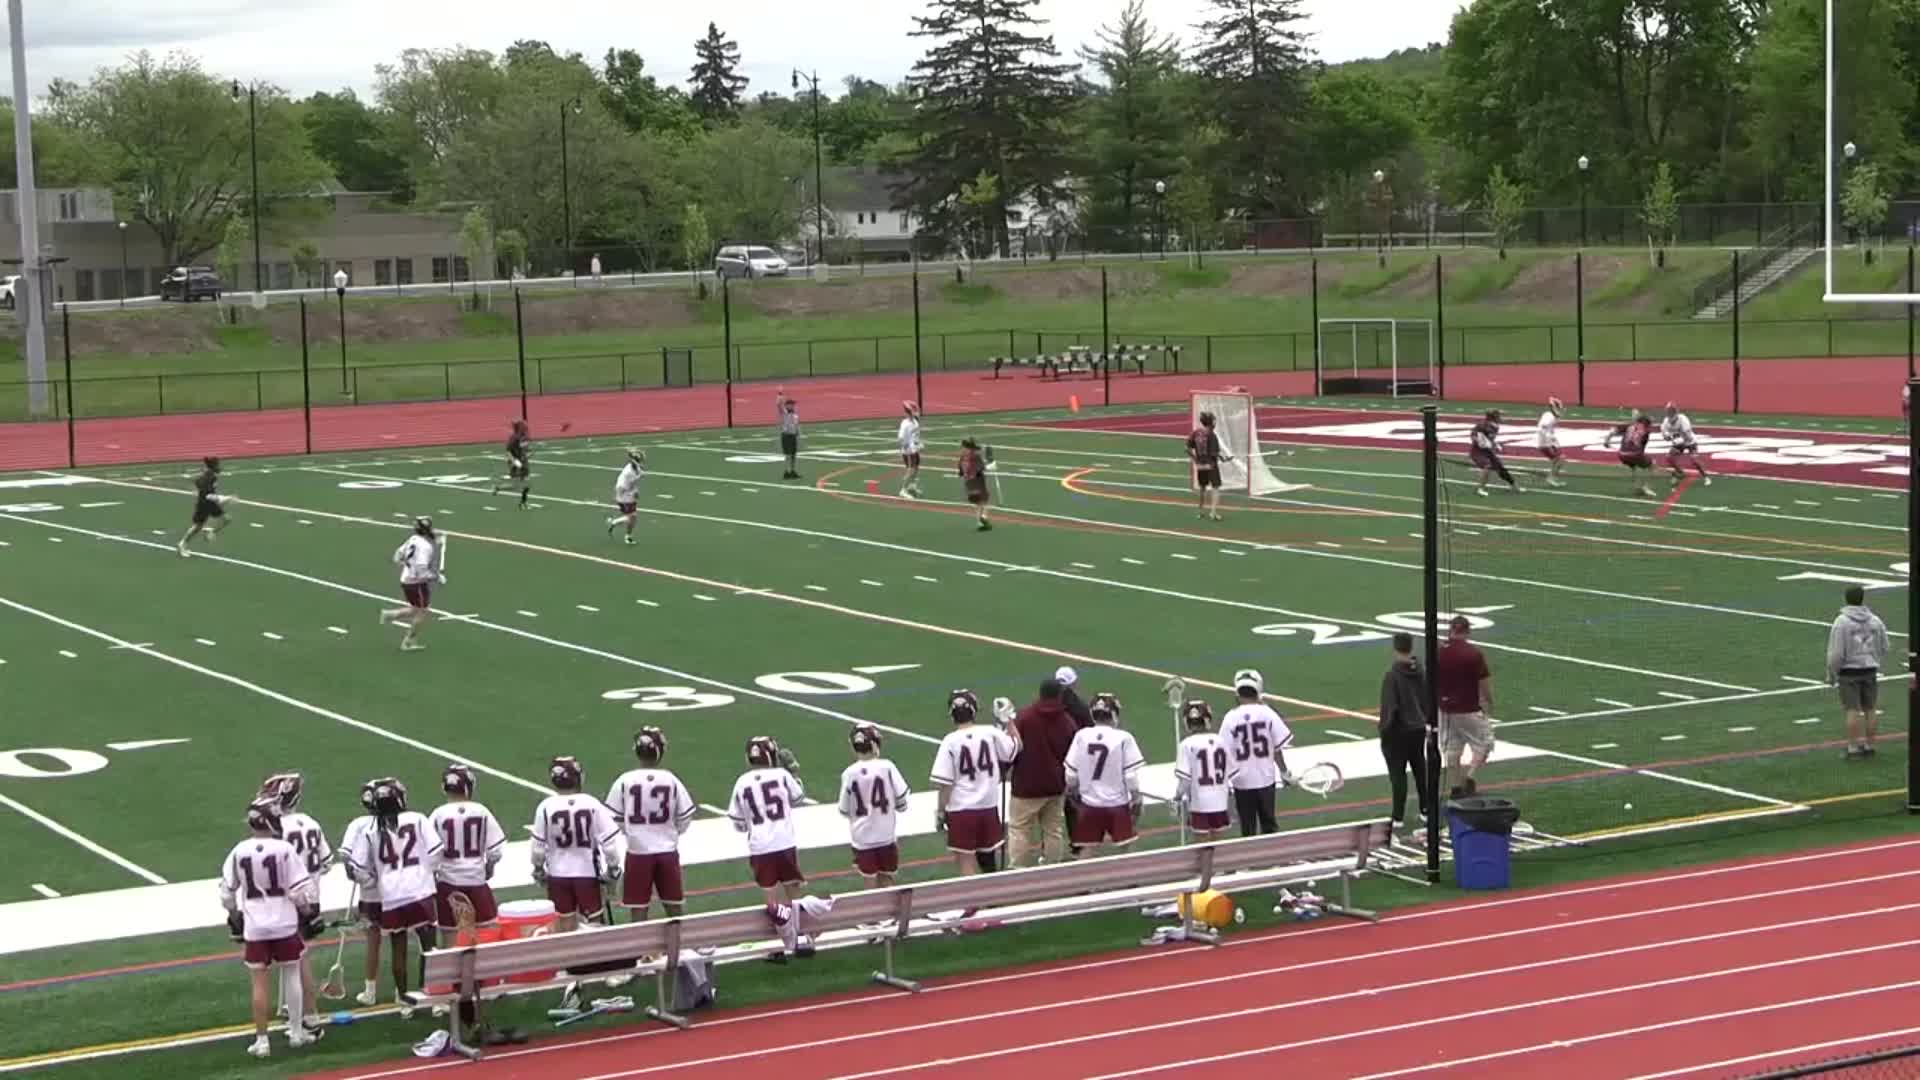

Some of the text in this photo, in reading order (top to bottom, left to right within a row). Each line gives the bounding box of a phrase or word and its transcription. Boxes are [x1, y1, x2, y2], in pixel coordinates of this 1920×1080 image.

[1087, 743, 1111, 780] 7
[1234, 722, 1270, 760] 35
[958, 745, 994, 781] 44
[1197, 748, 1228, 785] 19
[628, 783, 672, 825] 13
[742, 780, 786, 825] 15
[850, 776, 890, 817] 14
[378, 822, 420, 871] 42
[442, 816, 483, 859] 10
[550, 808, 593, 849] 30
[239, 853, 286, 900] 11
